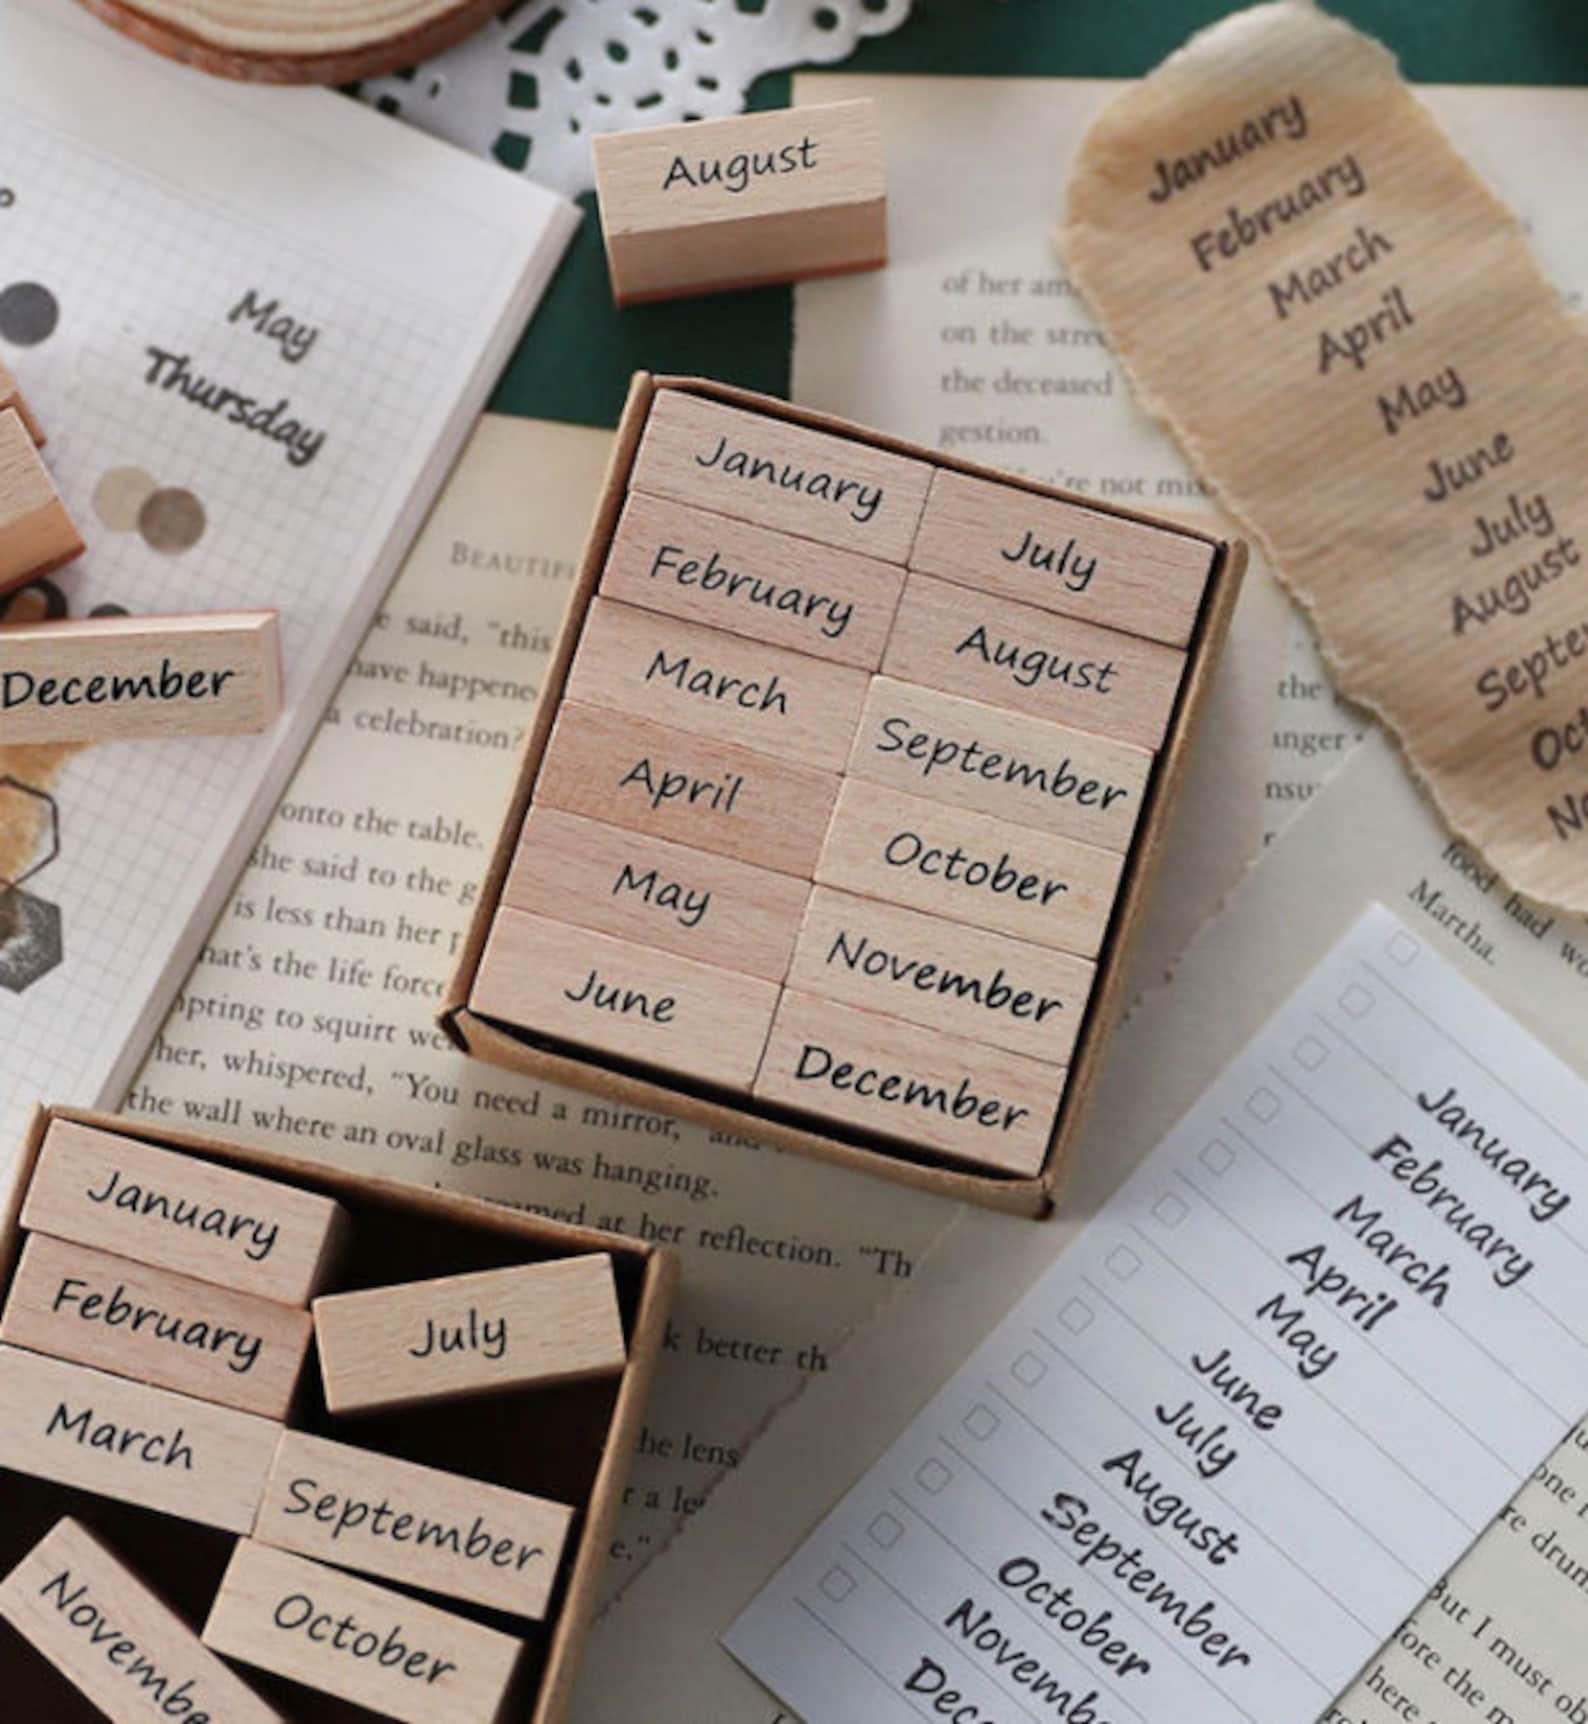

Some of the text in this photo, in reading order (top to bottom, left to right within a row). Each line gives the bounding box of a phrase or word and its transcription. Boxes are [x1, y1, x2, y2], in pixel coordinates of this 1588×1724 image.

[662, 136, 818, 192] August
[1147, 96, 1309, 205] January
[1191, 155, 1367, 272] February
[942, 269, 971, 296] of
[977, 272, 1022, 296] her
[1266, 226, 1396, 320] March
[227, 289, 320, 364] May
[940, 324, 977, 345] on
[989, 319, 1034, 346] the
[1317, 287, 1415, 375] April
[145, 346, 327, 468] Thursday
[941, 366, 1113, 396] the deceased
[1376, 366, 1468, 436] May
[938, 422, 1048, 449] gestion.
[1423, 431, 1517, 502] June
[695, 437, 885, 523] January
[1100, 475, 1147, 496] not
[1000, 533, 1098, 592] July
[1471, 494, 1555, 559] July
[651, 545, 855, 638] February
[1452, 536, 1582, 637] August
[405, 612, 470, 645] said,
[955, 626, 1119, 695] August
[2, 658, 236, 709] December
[646, 650, 790, 715] March
[1278, 672, 1322, 700] the
[1476, 622, 1588, 713] Septe
[353, 706, 525, 751] celebration?
[876, 716, 1129, 812] September
[619, 757, 743, 814] April
[280, 802, 484, 850] onto the table.
[303, 852, 359, 884] said
[368, 865, 397, 889] to
[406, 865, 452, 897] the
[611, 865, 711, 927] May
[885, 832, 1068, 908] October
[233, 889, 256, 919] is
[266, 895, 315, 926] less
[324, 905, 387, 938] than
[396, 914, 443, 947] her
[1407, 876, 1495, 967] Martha.
[1503, 891, 1556, 940] had
[273, 948, 318, 980] the
[328, 956, 374, 988] life
[564, 969, 678, 1024] June
[826, 931, 1062, 1026] November
[275, 1004, 304, 1030] to
[312, 1011, 397, 1044] squirt
[223, 1048, 375, 1097] whispered,
[473, 1089, 541, 1117] need
[552, 1103, 567, 1121] a
[581, 1103, 682, 1142] mirror,
[796, 1043, 1030, 1134] December
[127, 1083, 719, 1201] the wall where an oval glass was hanging.
[1416, 1086, 1572, 1224] January
[87, 1170, 279, 1263] January
[638, 1211, 686, 1243] her
[699, 1223, 842, 1269] reflection.
[1370, 1132, 1536, 1289] February
[1286, 1244, 1398, 1334] April
[1332, 1194, 1452, 1310] March
[52, 1277, 264, 1375] February
[409, 1308, 507, 1359] July
[695, 1326, 783, 1367] better
[1255, 1292, 1340, 1382] May
[1191, 1348, 1285, 1433] June
[46, 1402, 195, 1471] March
[681, 1431, 739, 1469] lens
[1154, 1401, 1239, 1480] July
[283, 1477, 543, 1573] September
[1102, 1448, 1242, 1567] August
[997, 1556, 1151, 1678] October
[1040, 1491, 1252, 1673] September
[273, 1591, 456, 1688] October
[944, 1597, 1112, 1724] Novemb
[1472, 1615, 1493, 1640] I
[1489, 1637, 1553, 1697] must
[1442, 1664, 1487, 1709] the
